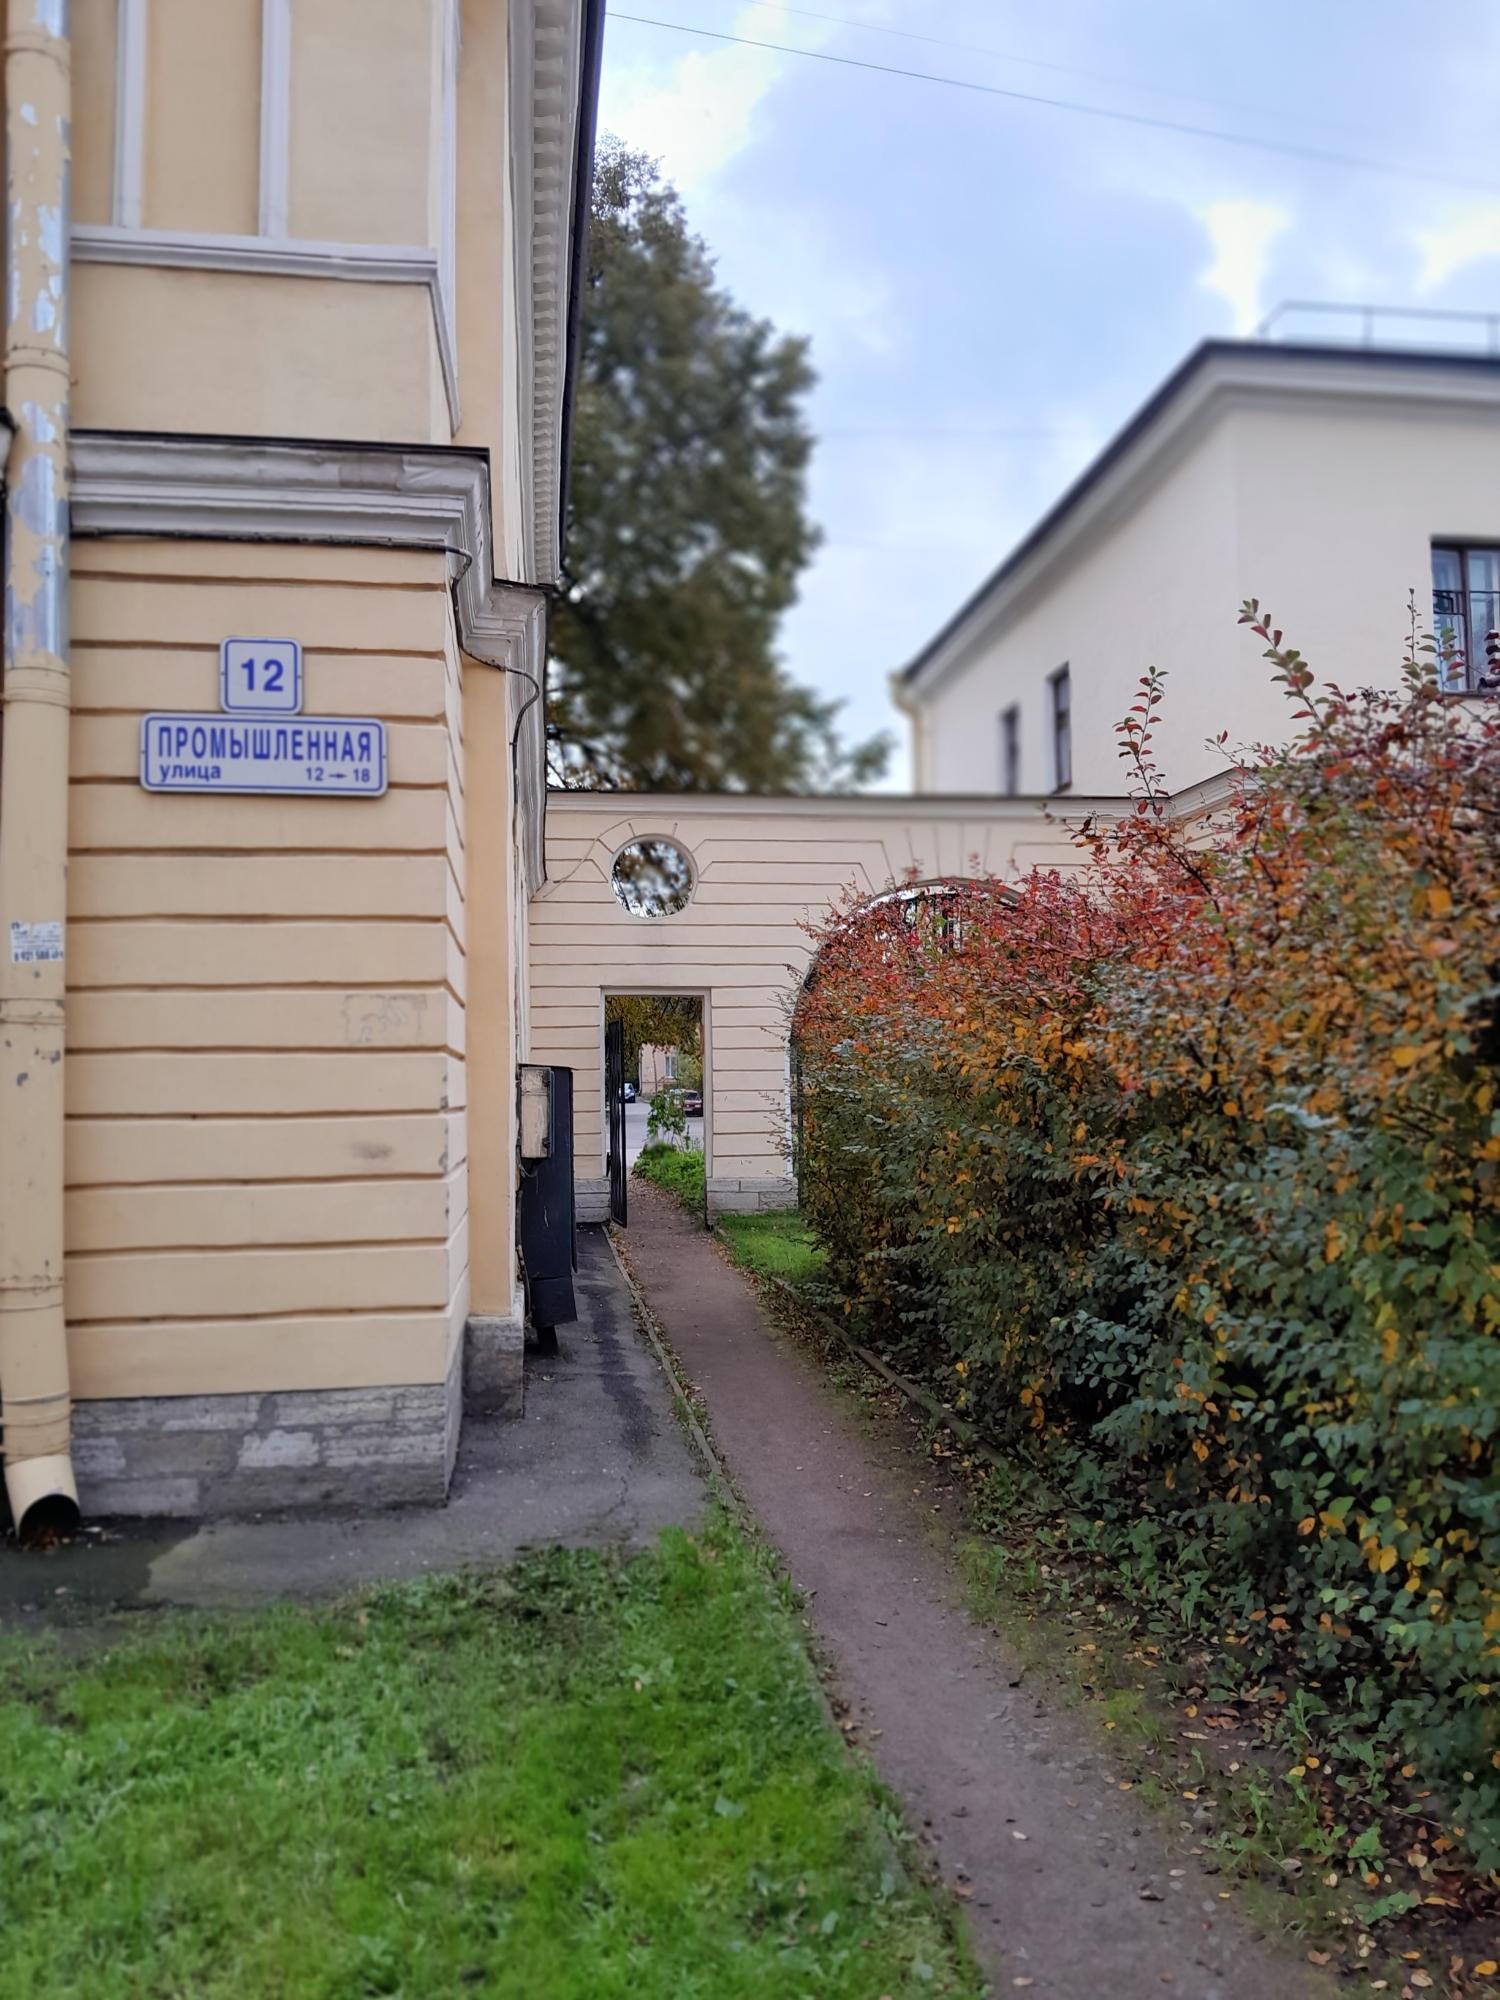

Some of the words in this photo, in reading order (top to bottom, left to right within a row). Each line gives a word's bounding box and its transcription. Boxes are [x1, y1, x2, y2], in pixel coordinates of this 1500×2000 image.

[241, 658, 284, 692] 12
[158, 726, 371, 762] ПРОМЫШЛЕННАЯ
[159, 764, 222, 782] улица
[306, 767, 324, 781] 12
[353, 768, 371, 782] 18
